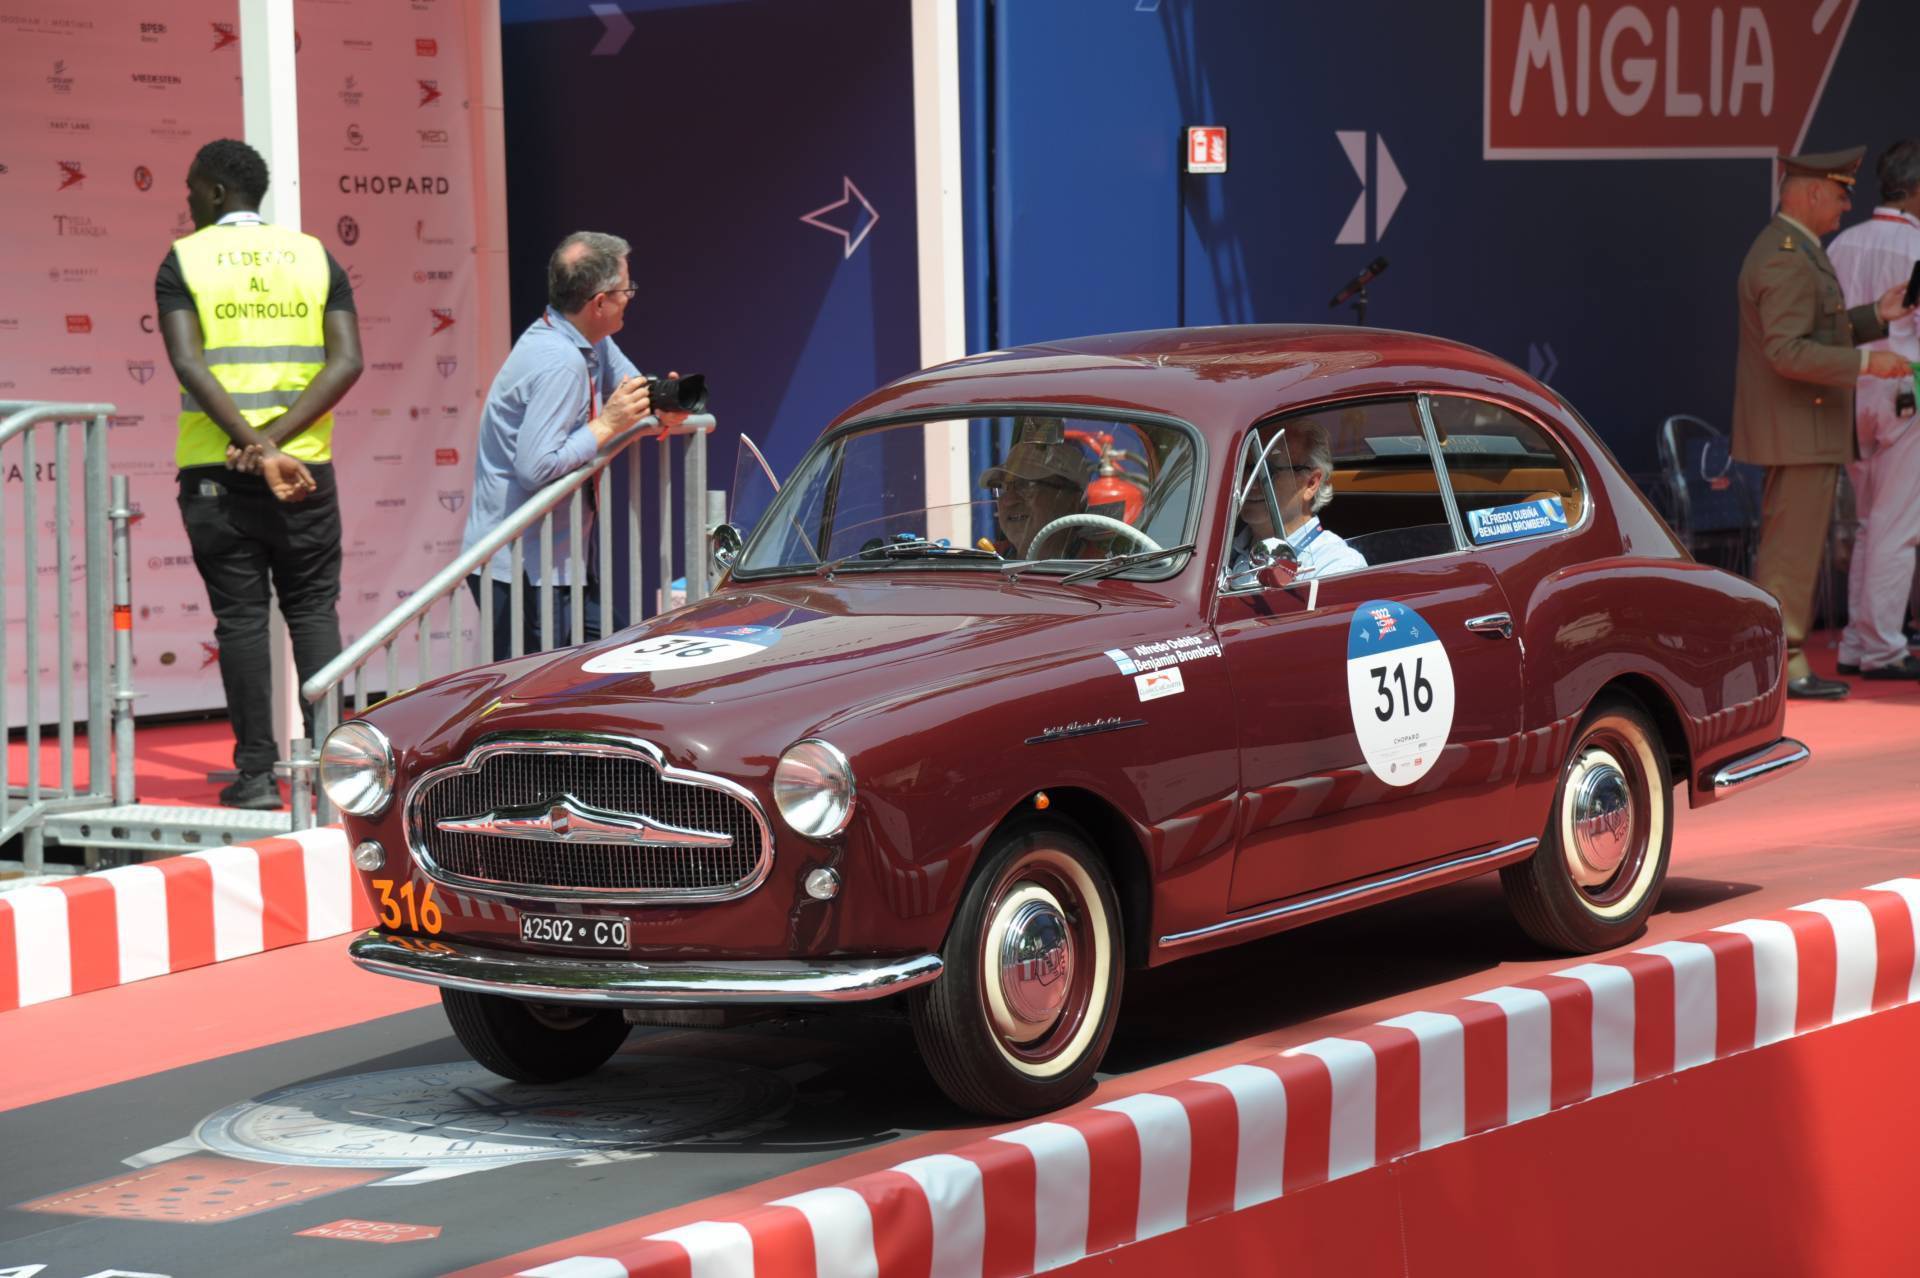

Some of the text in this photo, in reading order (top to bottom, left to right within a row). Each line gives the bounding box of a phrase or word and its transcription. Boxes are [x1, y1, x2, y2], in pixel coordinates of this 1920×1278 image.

[1509, 2, 1774, 117] MIGLIA
[339, 175, 450, 195] CHOPARD
[250, 276, 269, 293] AL
[215, 302, 309, 319] CONTROLLO
[1479, 517, 1551, 537] BENJAMIN BROMBERG
[1482, 511, 1513, 526] ALFREDO
[634, 639, 730, 658] 316
[1133, 641, 1169, 656] Alfredo
[1134, 644, 1222, 672] Benjamin Bromberg
[1370, 657, 1434, 722] 316
[372, 880, 442, 935] 316
[523, 917, 625, 945] 42502 CO
